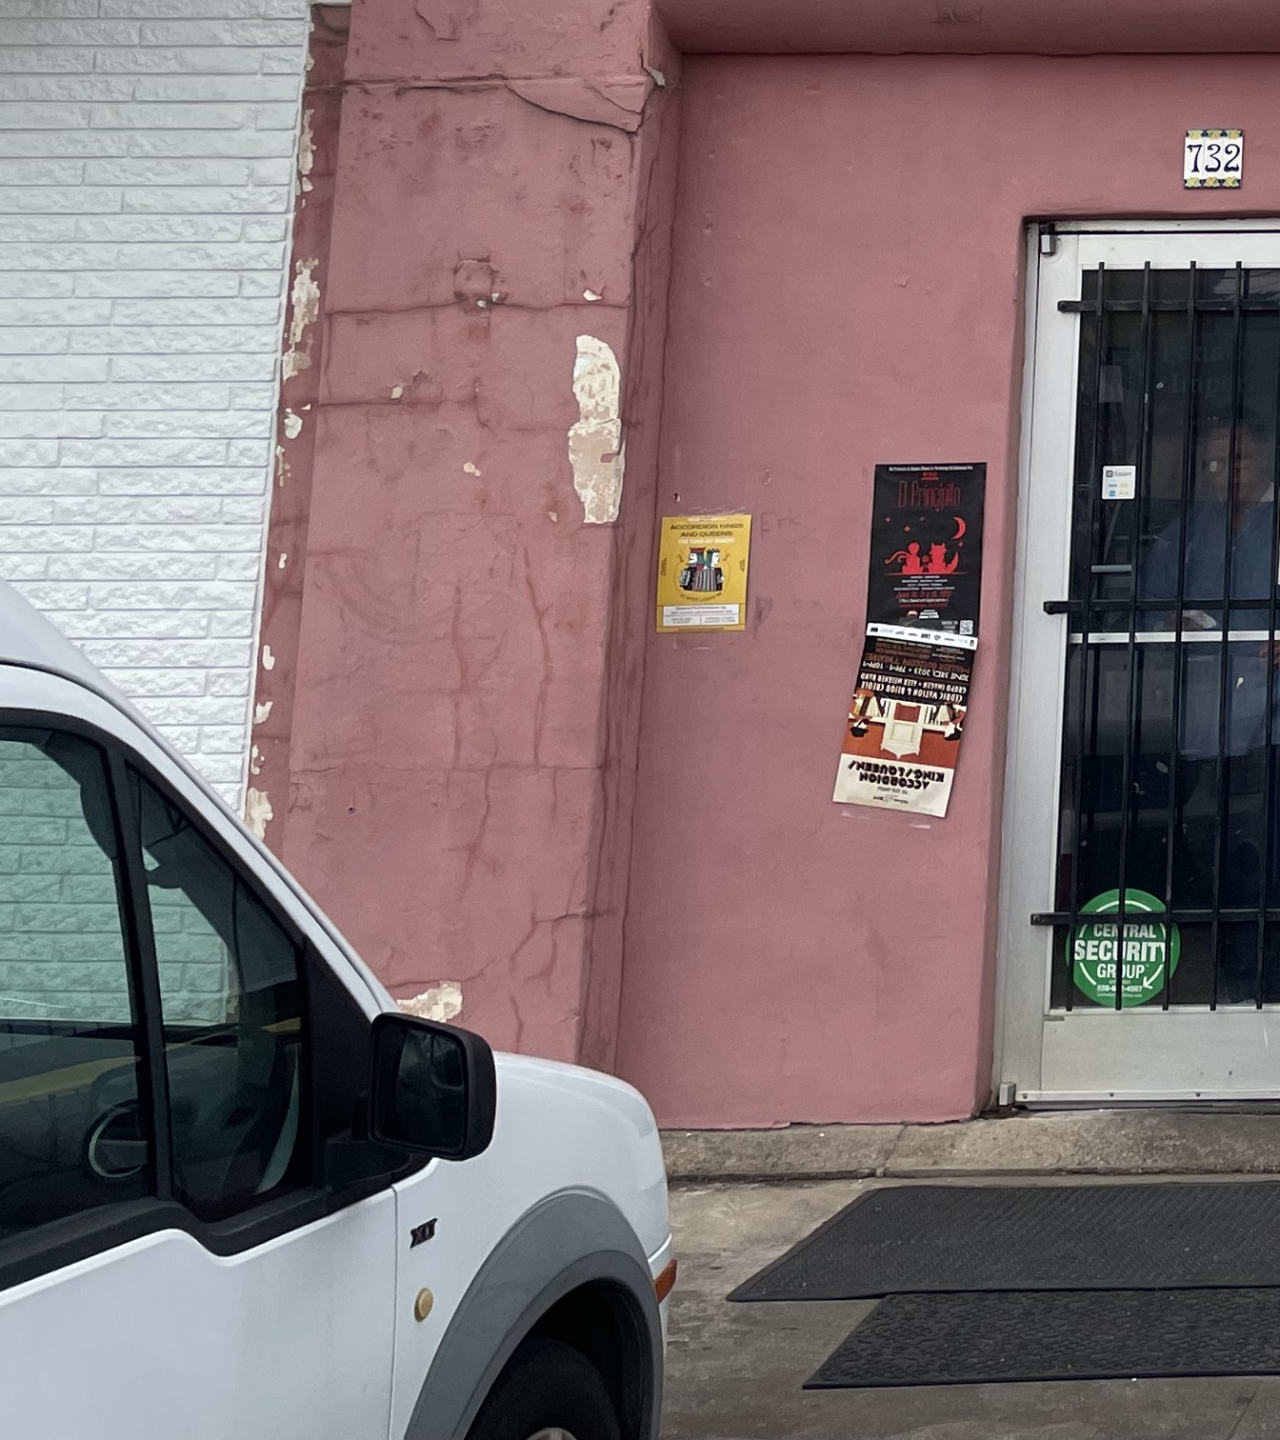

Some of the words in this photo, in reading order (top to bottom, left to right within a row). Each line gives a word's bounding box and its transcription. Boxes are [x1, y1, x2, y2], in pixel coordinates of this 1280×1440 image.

[1186, 143, 1241, 173] 732
[858, 772, 930, 791] ACCORDION
[1093, 923, 1157, 939] CENTRAL
